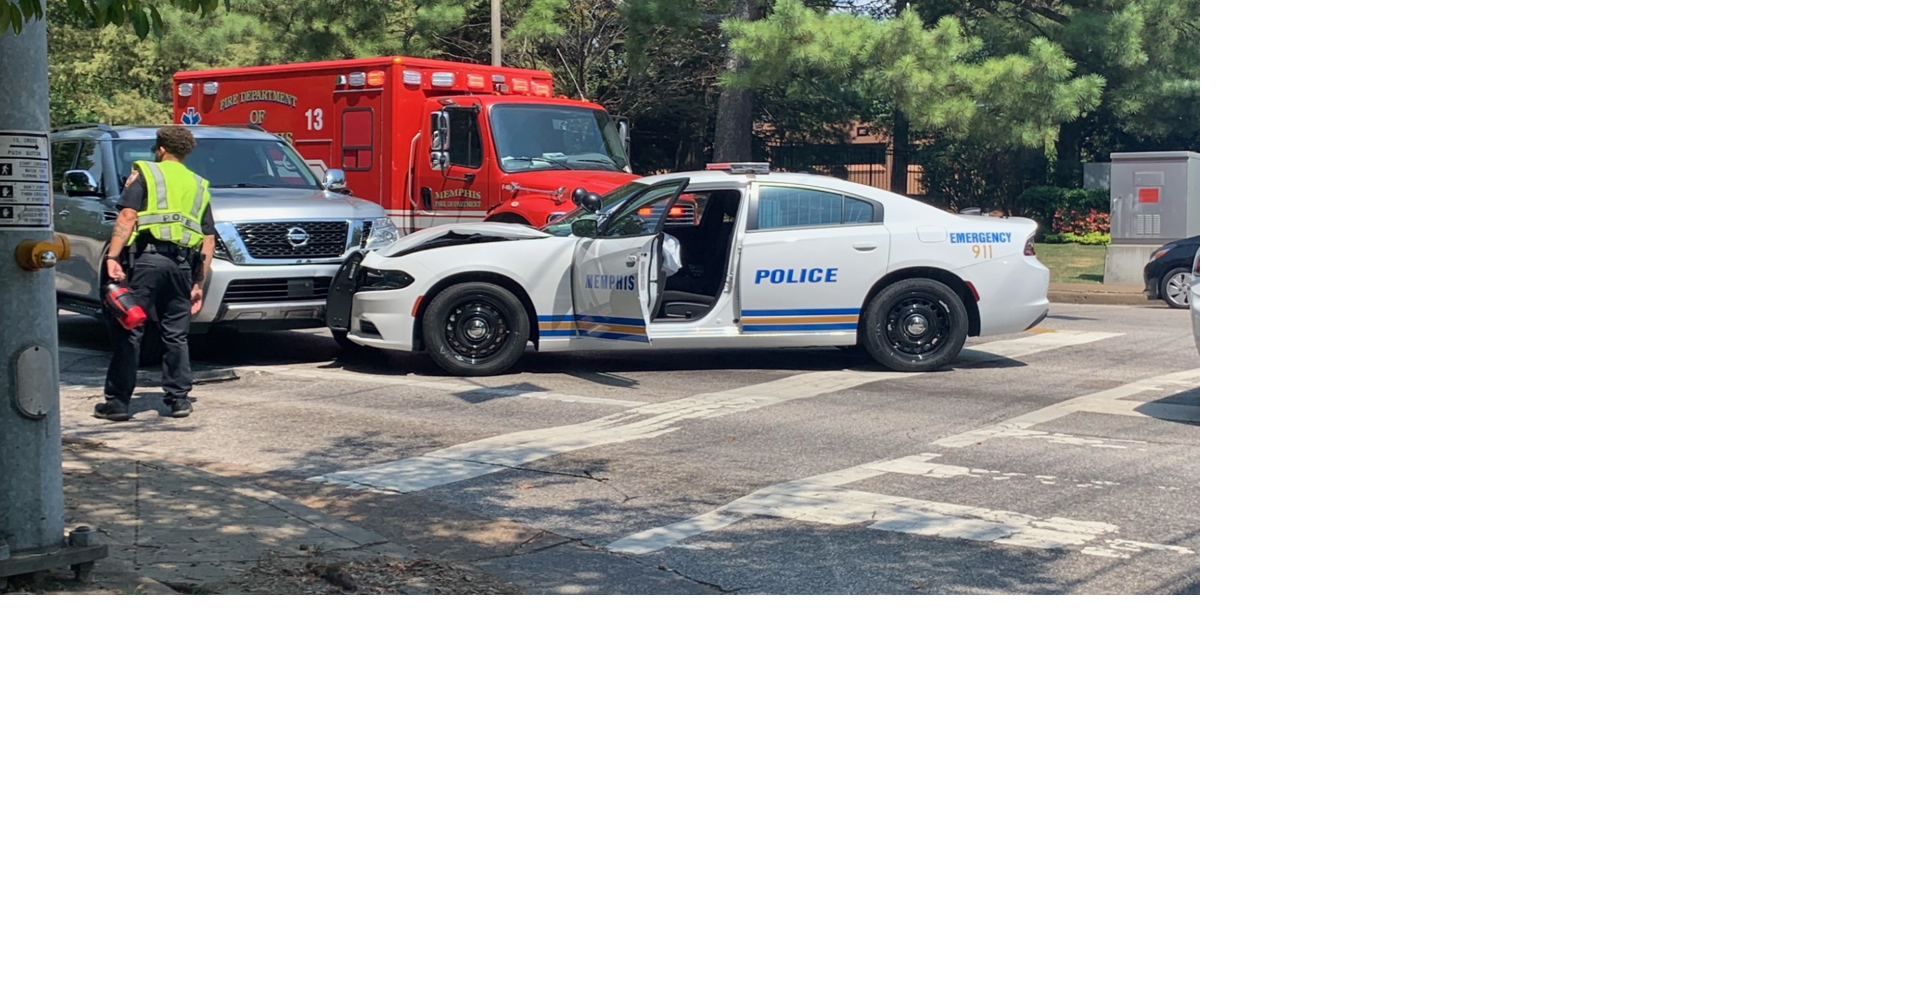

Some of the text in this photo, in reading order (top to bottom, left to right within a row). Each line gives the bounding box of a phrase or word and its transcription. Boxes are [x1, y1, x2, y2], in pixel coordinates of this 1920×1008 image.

[220, 89, 297, 111] FIRE DEPARTMENT
[249, 110, 266, 124] OF
[305, 108, 323, 131] 13
[434, 188, 481, 200] MEMPHIS
[949, 232, 1012, 244] EMERGENCY
[971, 244, 993, 260] 911
[584, 274, 635, 291] MEMPHIS
[754, 267, 839, 285] POLICE
